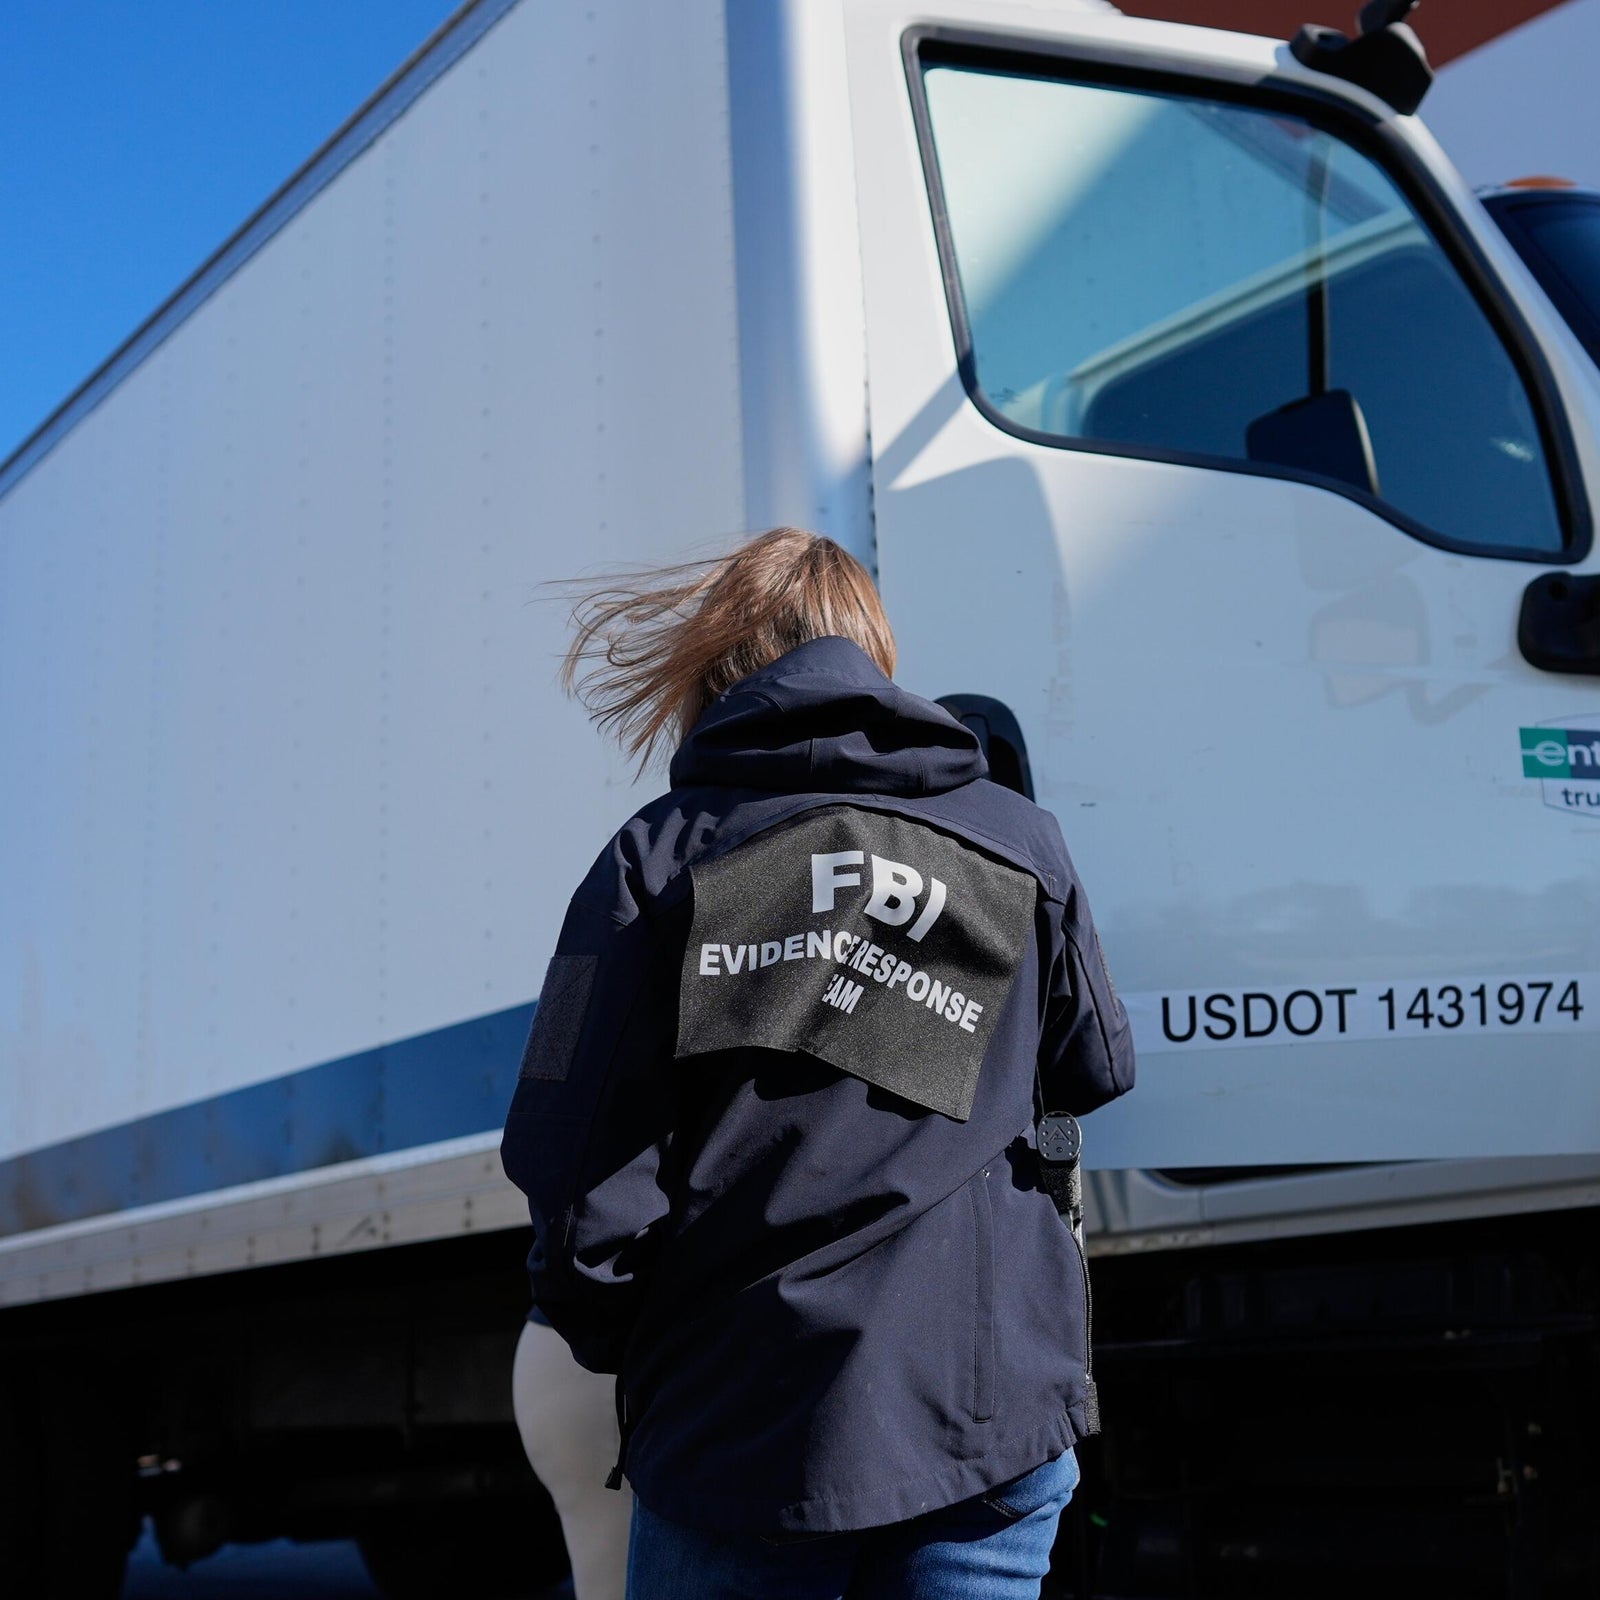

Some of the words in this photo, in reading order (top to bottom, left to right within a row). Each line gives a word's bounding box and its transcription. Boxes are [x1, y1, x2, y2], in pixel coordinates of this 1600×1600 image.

[1561, 787, 1600, 806] tru
[811, 850, 947, 942] FBI
[848, 939, 983, 1033] RESPONSE
[1161, 988, 1358, 1043] USDOT
[1378, 980, 1584, 1032] 1431974
